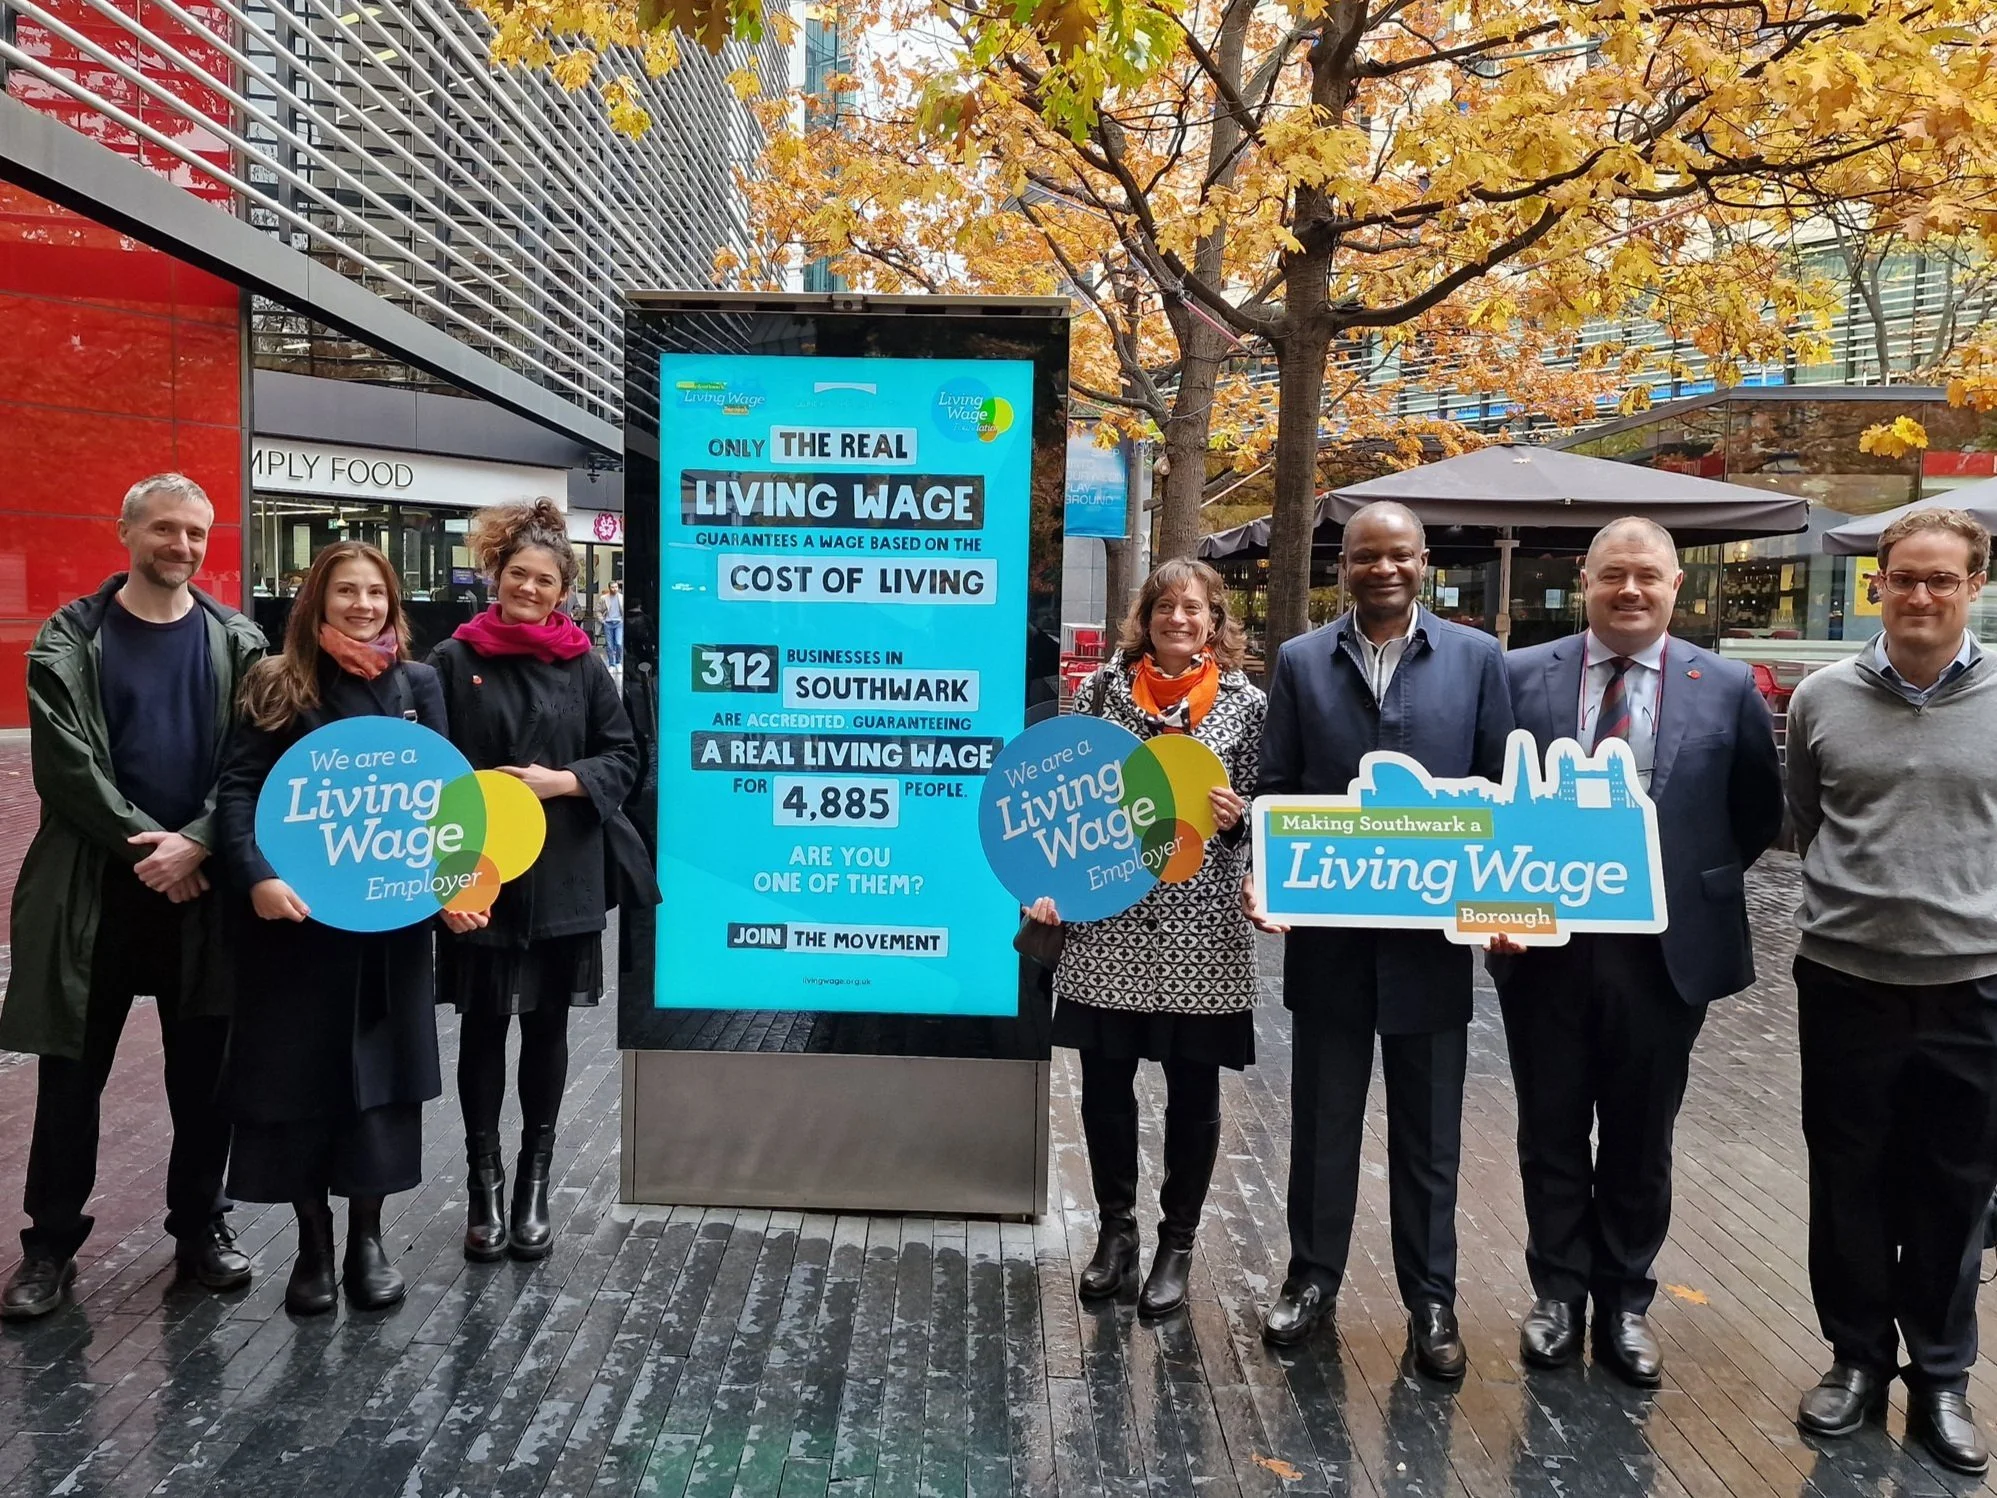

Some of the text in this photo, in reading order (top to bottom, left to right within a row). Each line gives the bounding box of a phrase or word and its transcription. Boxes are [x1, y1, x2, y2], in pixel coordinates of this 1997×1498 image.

[684, 389, 765, 408] Living Wage
[938, 391, 984, 410] Living
[947, 406, 988, 423] Wage
[708, 431, 908, 459] ONLY THE REAL
[331, 457, 413, 488] FOOD
[695, 480, 974, 521] LIVING WAGE
[695, 532, 982, 552] GUARANTEES A WAGE BASED ON THE
[729, 565, 984, 595] COST OF LIVING
[701, 649, 903, 687] 312 BUSINESSES IN
[795, 676, 968, 702] SOUTHWARK
[712, 712, 742, 727] ARE
[853, 716, 972, 731] GUARANTEEING
[310, 749, 417, 772] We are a
[701, 740, 993, 769] A REAL LIVING WAGE
[1004, 739, 1093, 789] We are a
[283, 774, 443, 823] Living
[733, 778, 968, 820] FOR 4,885 PEOPLE.
[996, 759, 1126, 841] Living
[1032, 797, 1156, 868] Wage
[1282, 815, 1482, 833] Making Southwark a
[319, 818, 463, 868] Wage
[789, 846, 891, 868] ARE YOU
[1086, 835, 1184, 891] Employer
[1283, 842, 1628, 907] Living Wage
[365, 869, 483, 901] Employer
[753, 873, 924, 896] ONE OF THEM?
[1461, 908, 1552, 926] Borough
[733, 927, 940, 951] JOIN THE MOVEMENT
[802, 976, 871, 986] livingwage.org.uk
